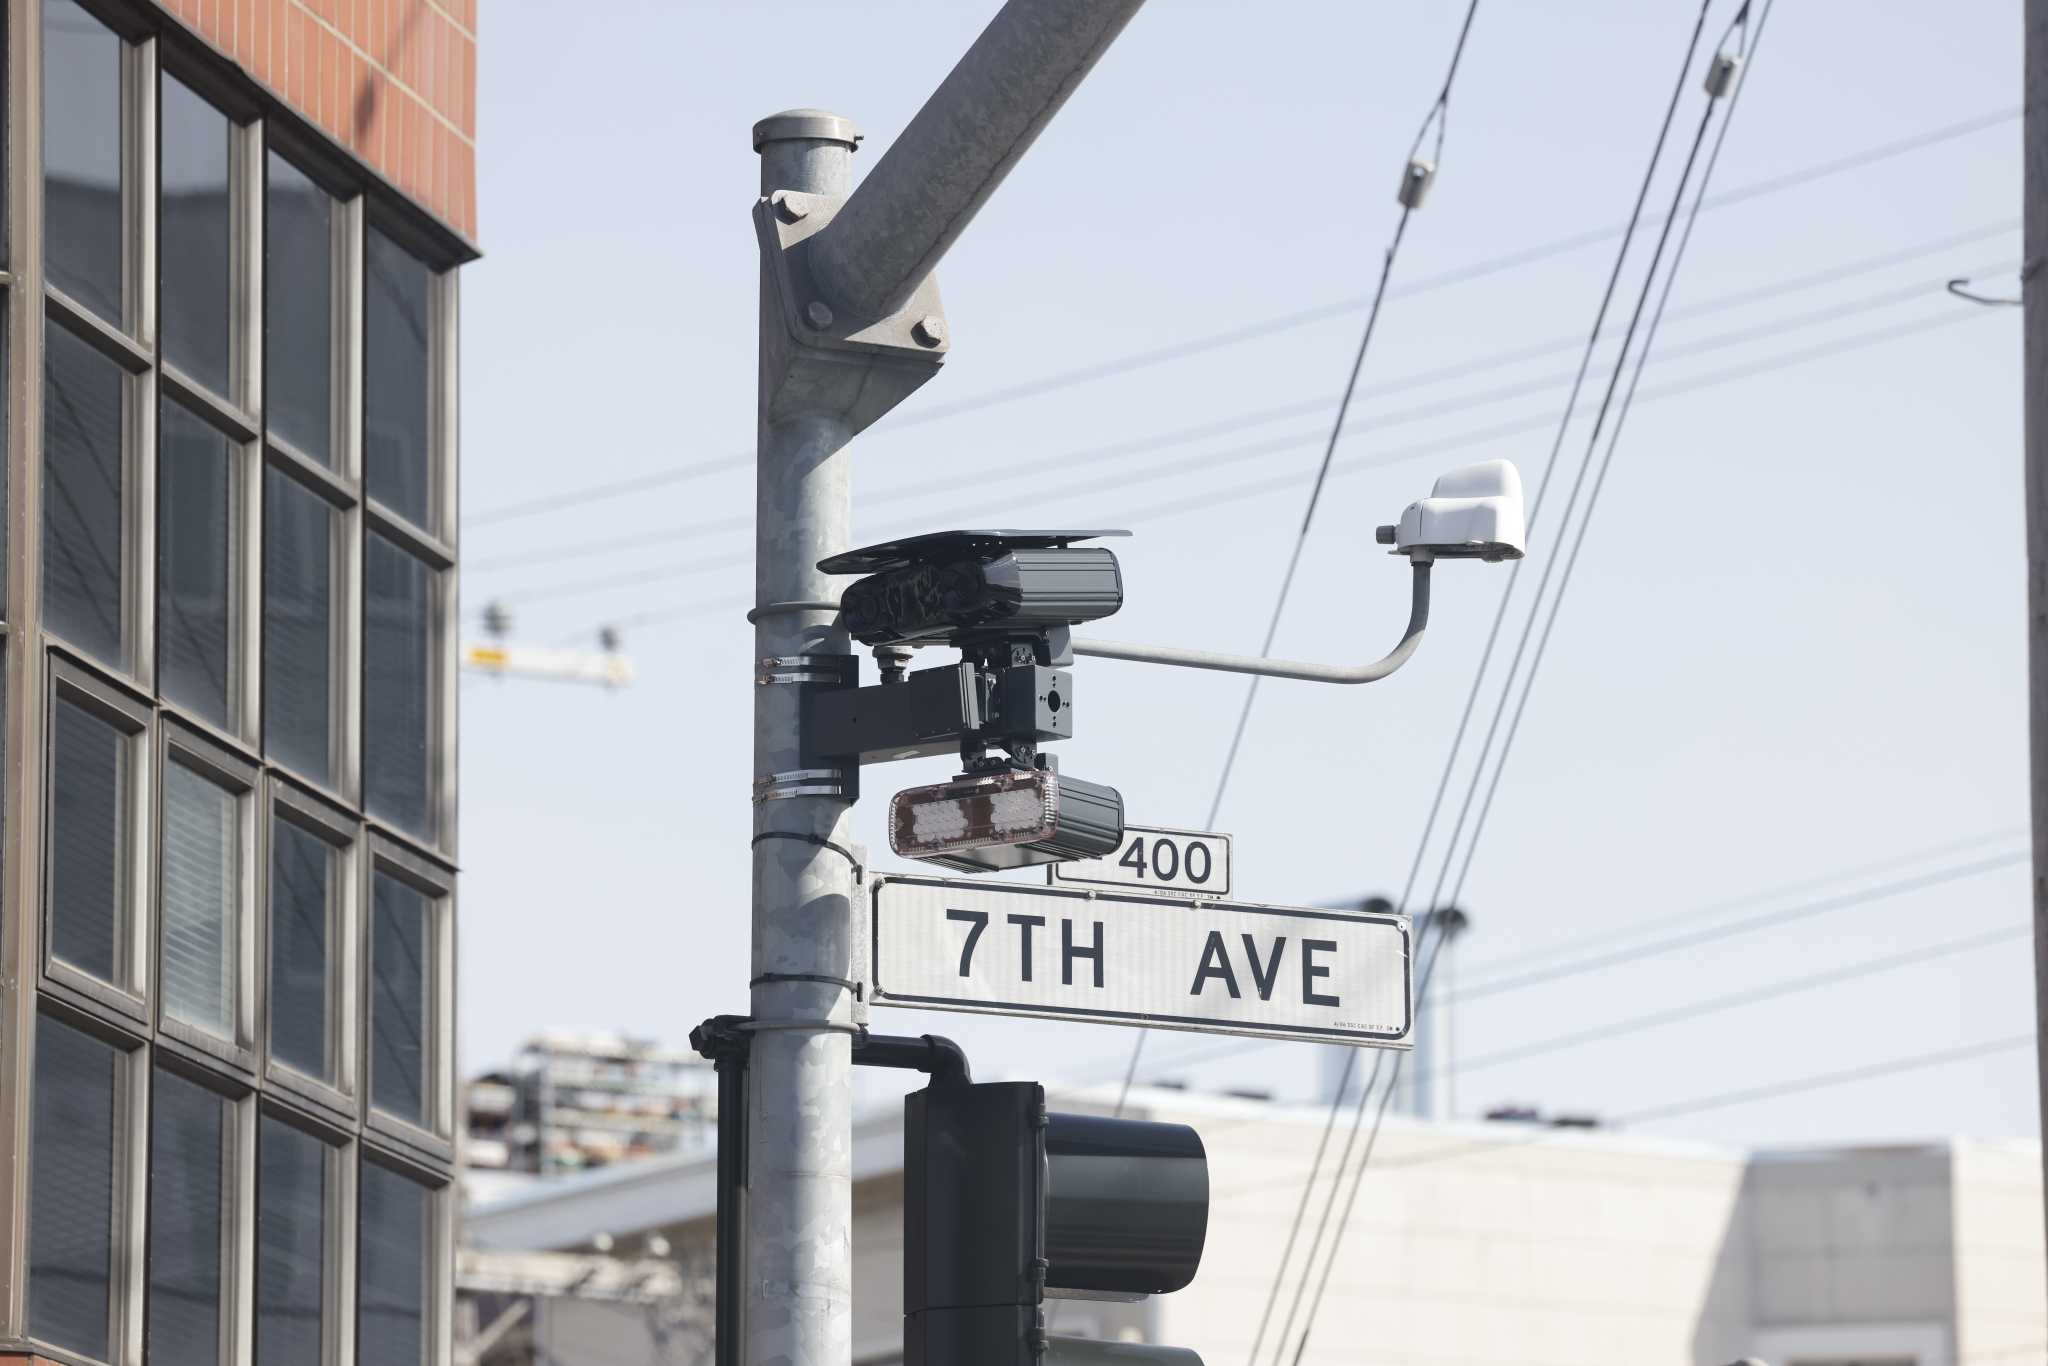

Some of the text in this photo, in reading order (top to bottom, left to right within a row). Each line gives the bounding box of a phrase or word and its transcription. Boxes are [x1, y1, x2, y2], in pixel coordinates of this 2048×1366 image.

[1118, 836, 1212, 885] 400
[946, 908, 1340, 1008] 7TH AVE
